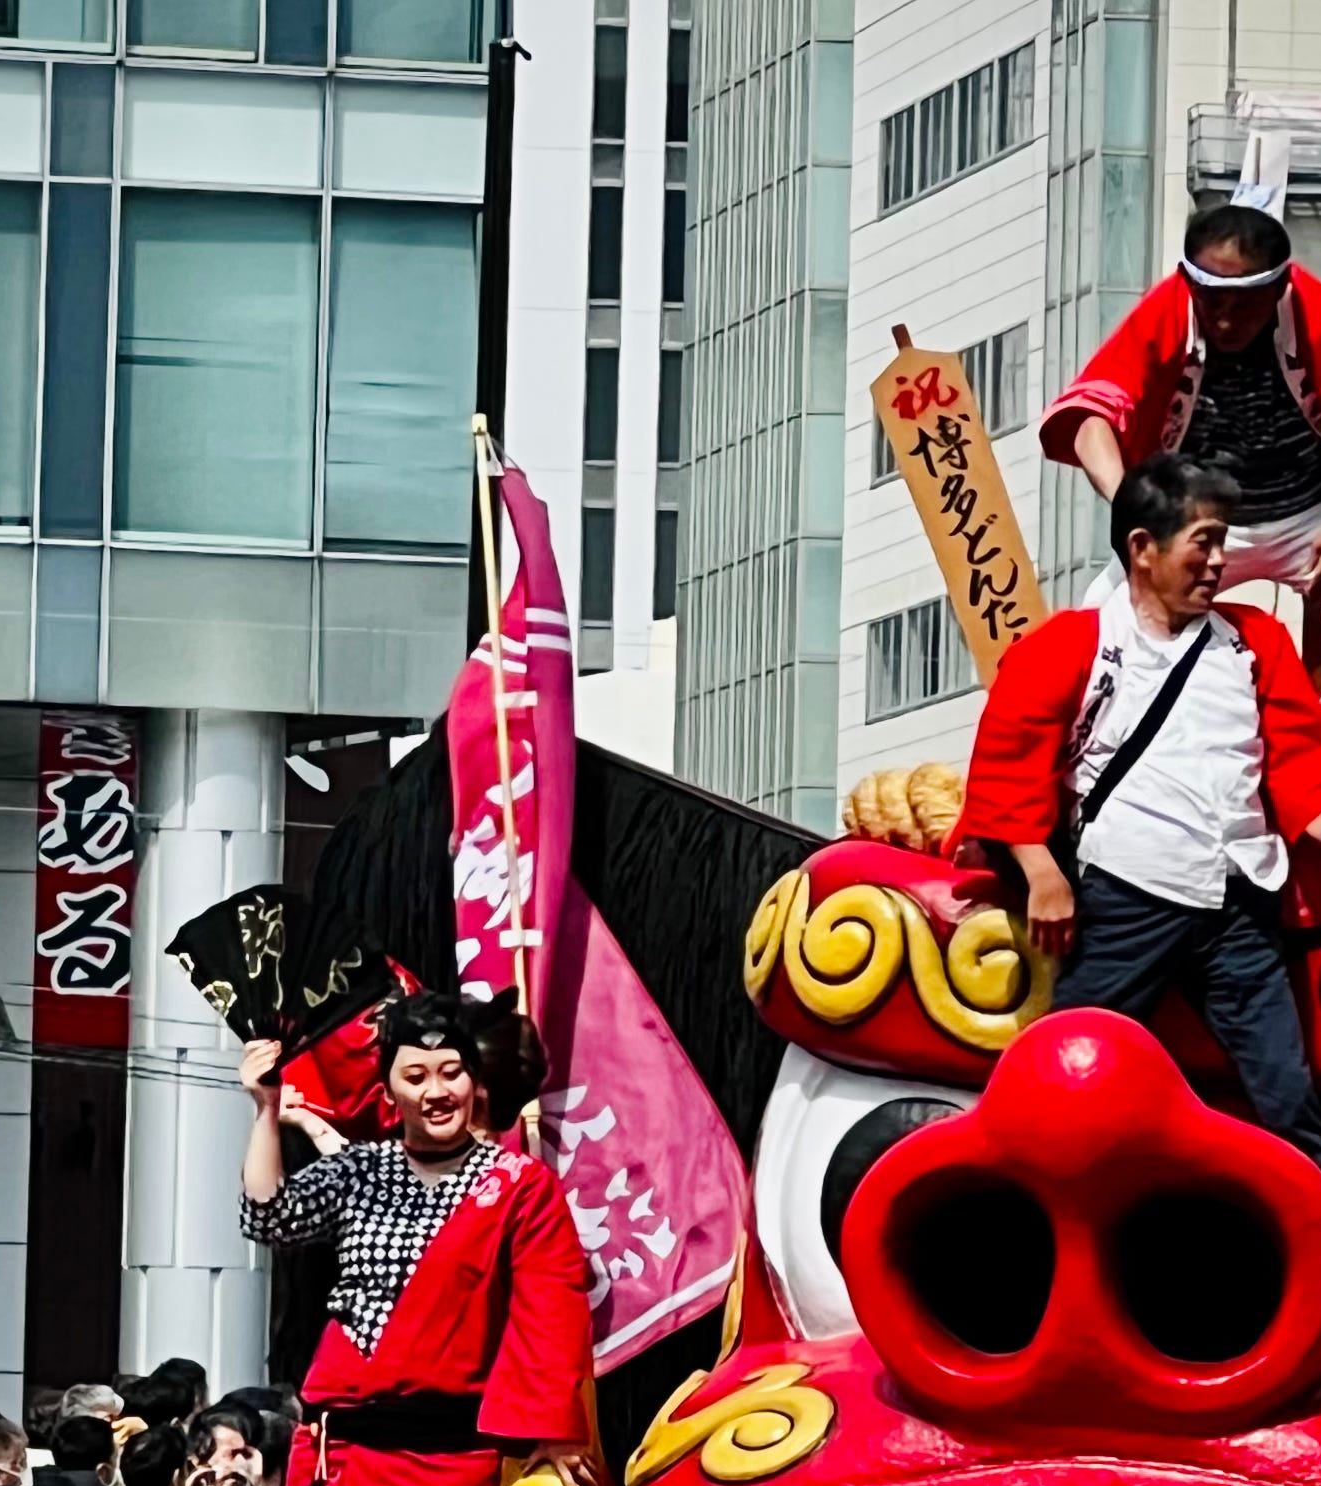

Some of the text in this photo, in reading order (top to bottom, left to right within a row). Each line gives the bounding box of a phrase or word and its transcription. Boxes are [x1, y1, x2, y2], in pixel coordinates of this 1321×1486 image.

[891, 366, 1029, 645] 祝博多どんた
